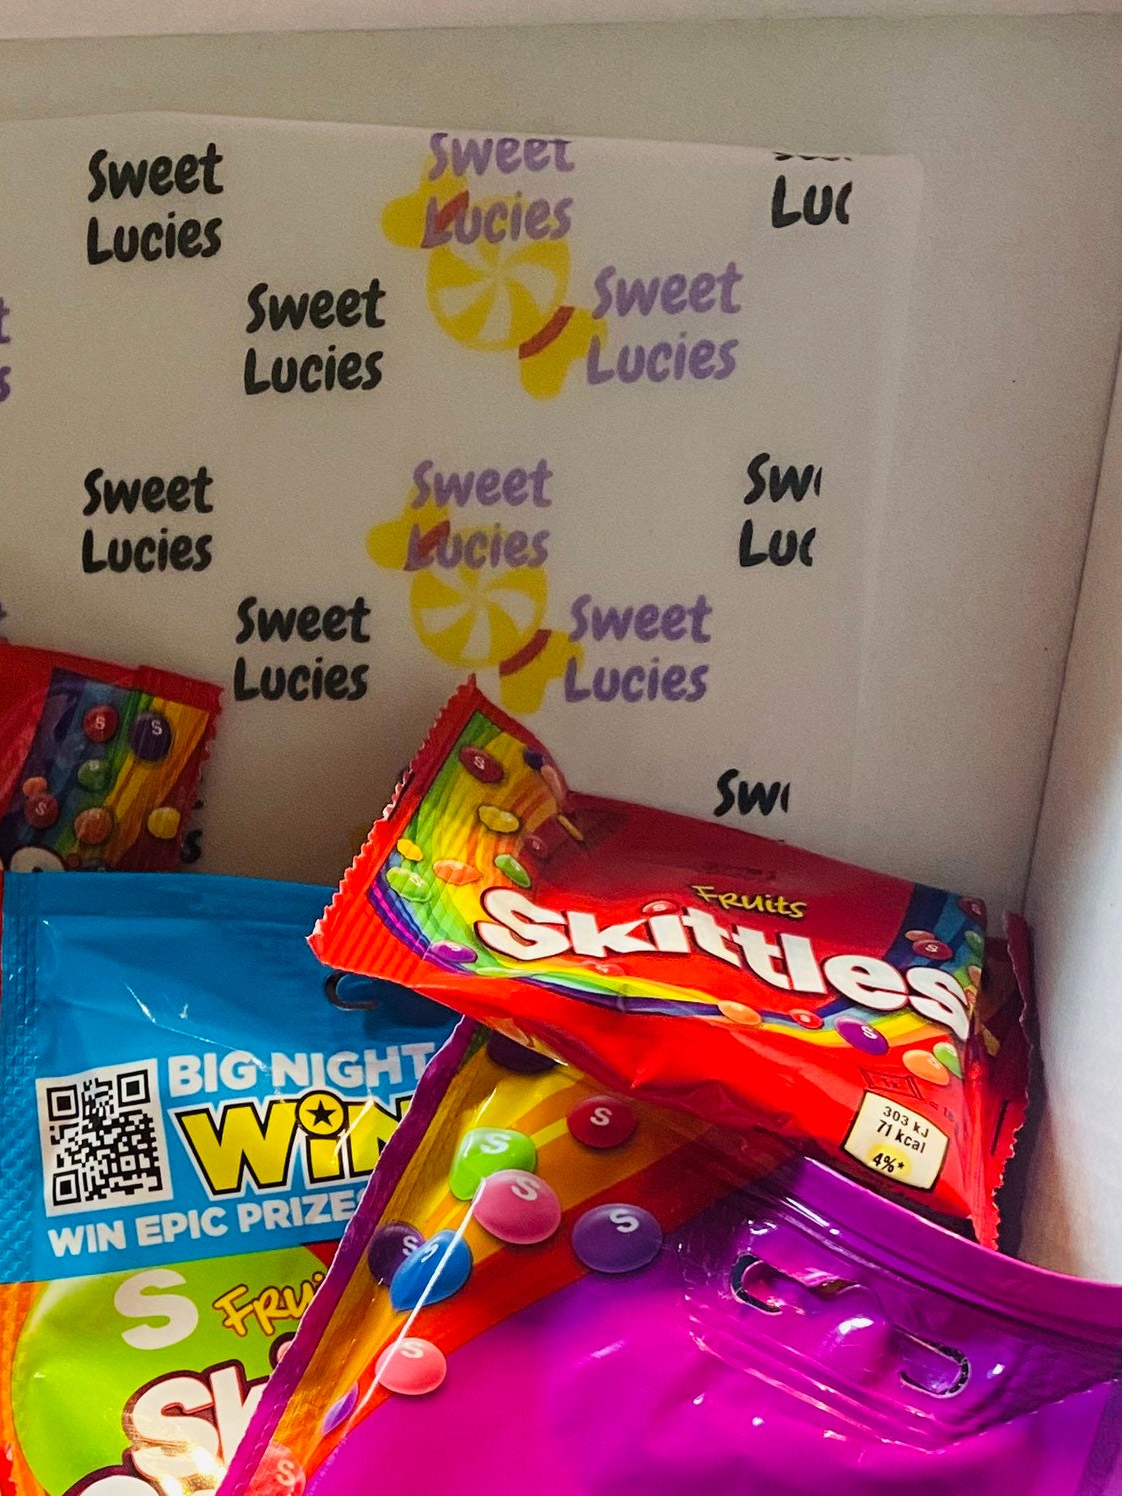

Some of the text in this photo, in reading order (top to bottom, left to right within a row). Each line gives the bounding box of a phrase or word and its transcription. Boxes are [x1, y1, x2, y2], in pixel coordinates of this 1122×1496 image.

[88, 142, 224, 203] Sweet
[87, 211, 223, 265] Lucies
[421, 190, 574, 249] Lucies
[246, 278, 386, 334] Sweet
[592, 263, 744, 320] Sweet
[243, 340, 384, 395] Lucies
[586, 328, 738, 386] Lucies
[82, 466, 214, 517] Sweet
[410, 459, 554, 510] Sweet
[82, 524, 213, 575] Lucies
[405, 519, 550, 571] Lucies
[234, 596, 371, 645] Sweet
[568, 594, 713, 643] Sweet
[233, 654, 369, 702] Lucies
[563, 654, 709, 704] Lucies
[691, 883, 808, 920] Fruits
[480, 888, 970, 1039] Skittles
[167, 1041, 436, 1098] BIG NIGHT
[876, 1118, 927, 1154] 71 kcal
[882, 1105, 930, 1139] 303 kJ
[48, 1190, 366, 1258] WIN EPIC PRIZE
[113, 1267, 199, 1350] S
